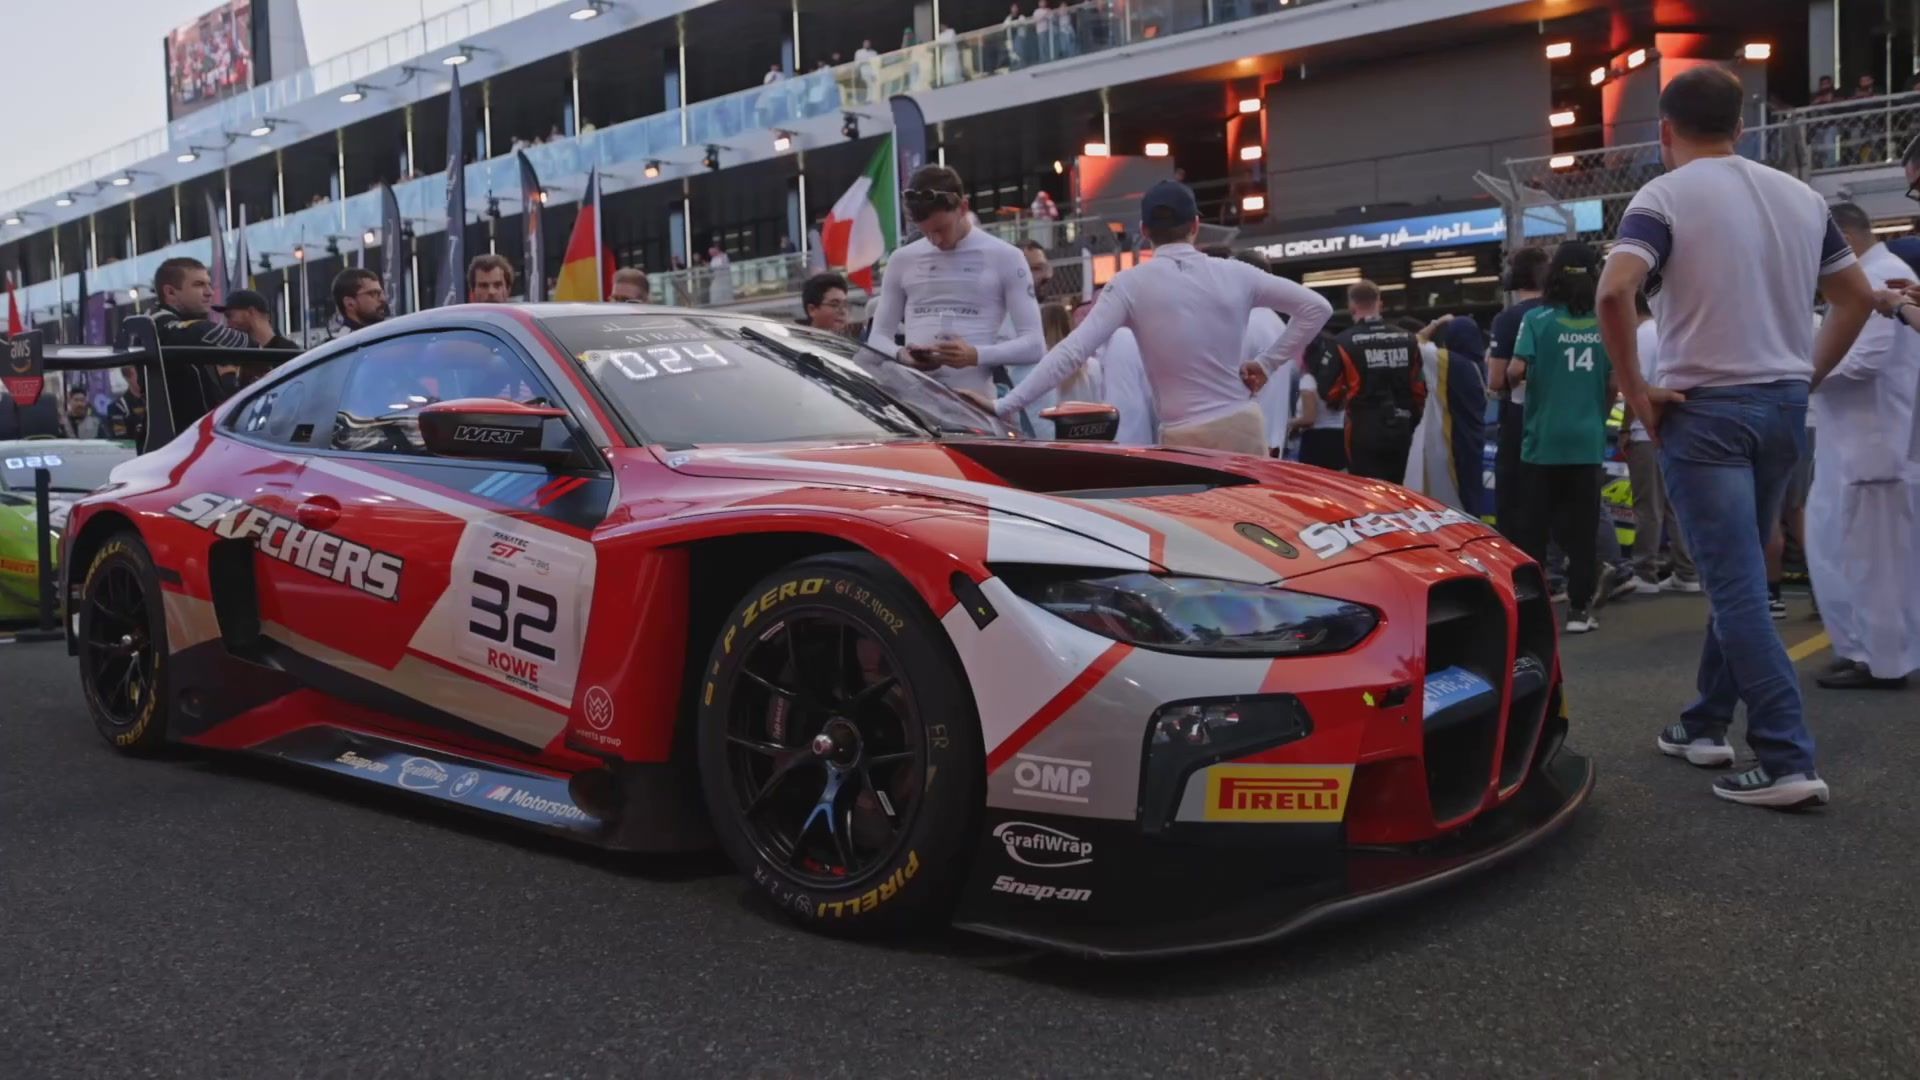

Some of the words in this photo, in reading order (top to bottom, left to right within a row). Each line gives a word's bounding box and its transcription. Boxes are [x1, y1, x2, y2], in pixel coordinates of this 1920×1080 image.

[1285, 237, 1346, 257] CIRCUIT
[609, 343, 728, 380] 024
[1564, 347, 1595, 372] 14
[453, 425, 525, 444] WRT
[168, 492, 403, 602] SKECHERS
[469, 569, 558, 662] 32
[743, 577, 825, 629] ZERO
[487, 647, 540, 683] ROWE
[1014, 761, 1091, 794] OMP
[1218, 777, 1340, 811] PIRELLI
[1001, 830, 1093, 857] GrafiWrap
[817, 850, 920, 918] PIRELLI
[992, 875, 1092, 901] Snap-on
